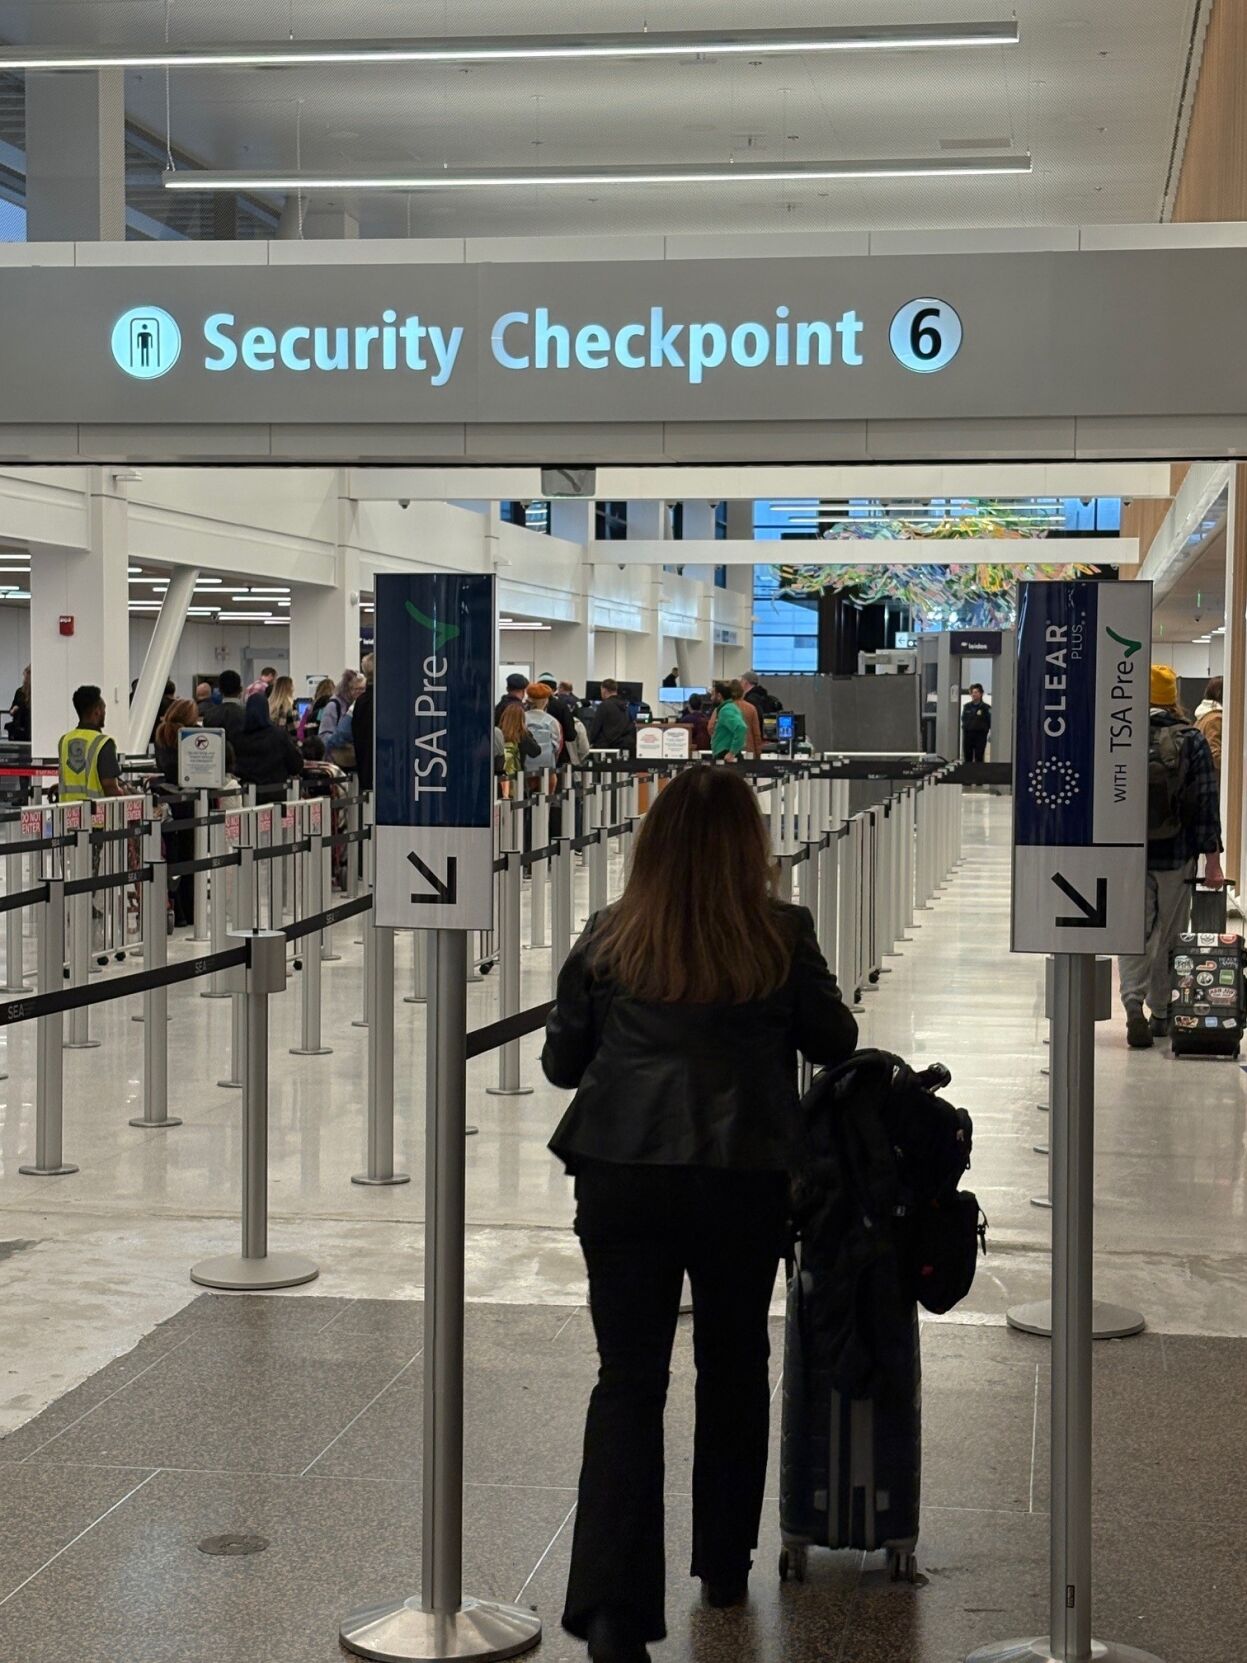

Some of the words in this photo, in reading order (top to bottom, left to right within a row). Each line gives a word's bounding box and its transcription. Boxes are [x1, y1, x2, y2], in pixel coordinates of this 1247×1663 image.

[203, 308, 464, 386] Security
[490, 305, 863, 384] Checkpoint
[909, 307, 942, 361] 6
[1071, 624, 1083, 660] PLUS
[414, 655, 448, 717] Pre
[1044, 624, 1068, 738] CLEAR
[1111, 660, 1134, 700] Pre
[1110, 707, 1133, 753] TSA
[414, 729, 448, 801] TSA
[1113, 763, 1127, 803] WITH
[22, 822, 41, 834] ENTER
[195, 961, 208, 974] SEA
[7, 1005, 25, 1020] SEA
